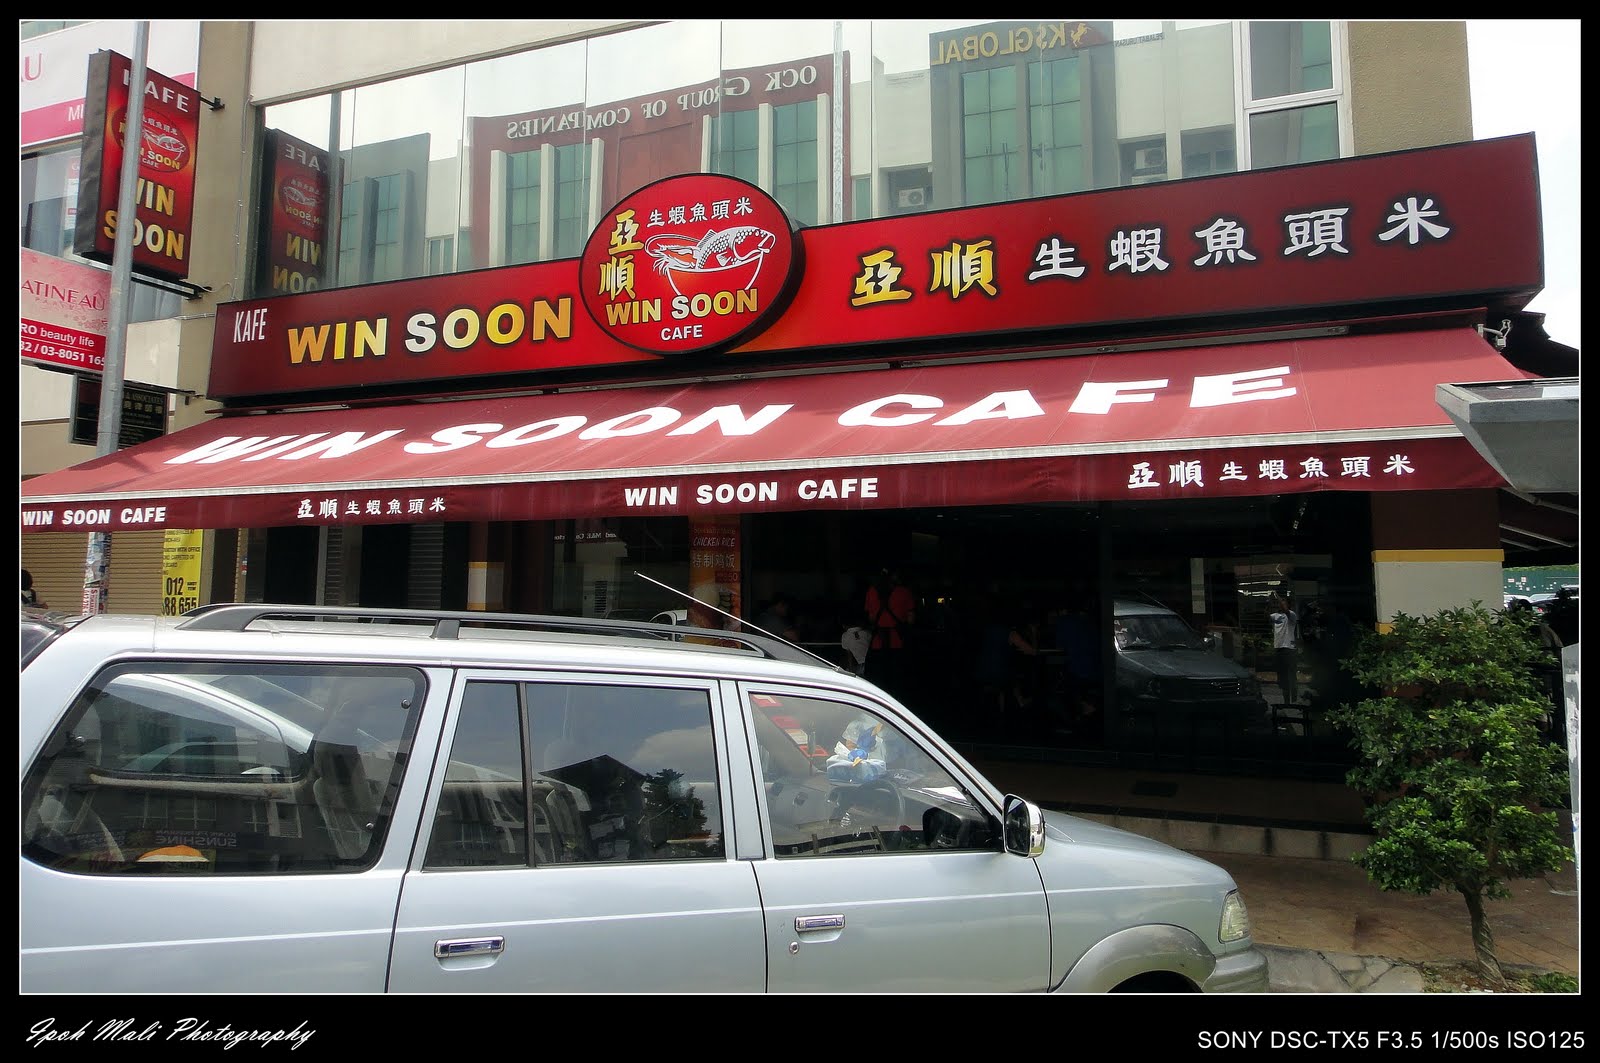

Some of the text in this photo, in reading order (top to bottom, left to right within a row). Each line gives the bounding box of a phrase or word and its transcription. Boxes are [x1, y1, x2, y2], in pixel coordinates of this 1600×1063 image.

[20, 53, 42, 81] U
[147, 149, 180, 170] SOON
[646, 196, 753, 228] 生蝦魚頭米
[1028, 196, 1451, 281] 生蝦魚頭米
[605, 288, 758, 327] WIN SOON
[40, 327, 77, 345] beauty
[79, 335, 95, 347] life
[233, 308, 269, 343] KAFE
[287, 297, 572, 364] WIN SOON
[660, 324, 703, 341] CAFE
[163, 365, 1298, 465] WIN SOON CAFE
[624, 477, 879, 507] WIN SOON CAFE
[22, 506, 167, 526] WIN SOON CAFE
[166, 577, 185, 596] 012
